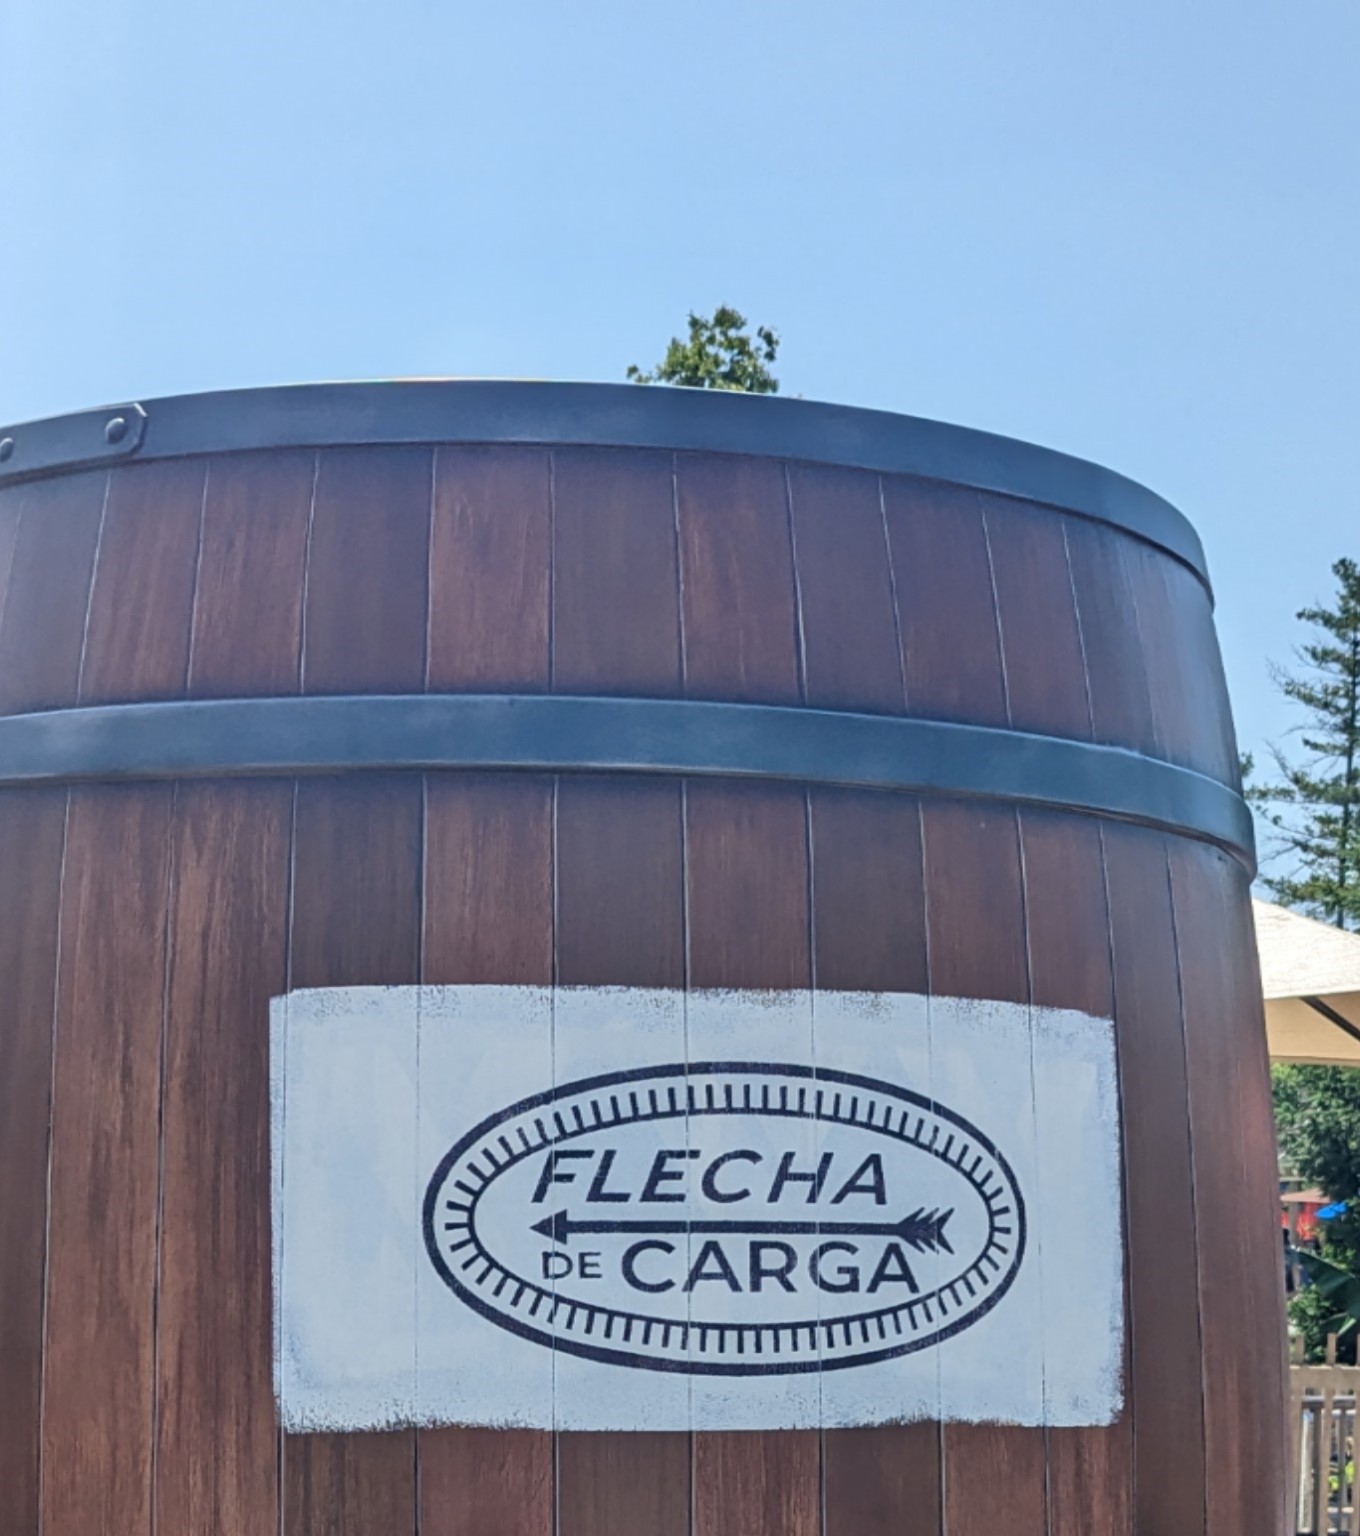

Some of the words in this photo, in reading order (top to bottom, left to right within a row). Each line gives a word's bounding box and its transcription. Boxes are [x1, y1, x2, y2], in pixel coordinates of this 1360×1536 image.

[531, 1149, 888, 1206] FLECHA
[541, 1250, 602, 1280] DE
[621, 1240, 920, 1294] CARGA
